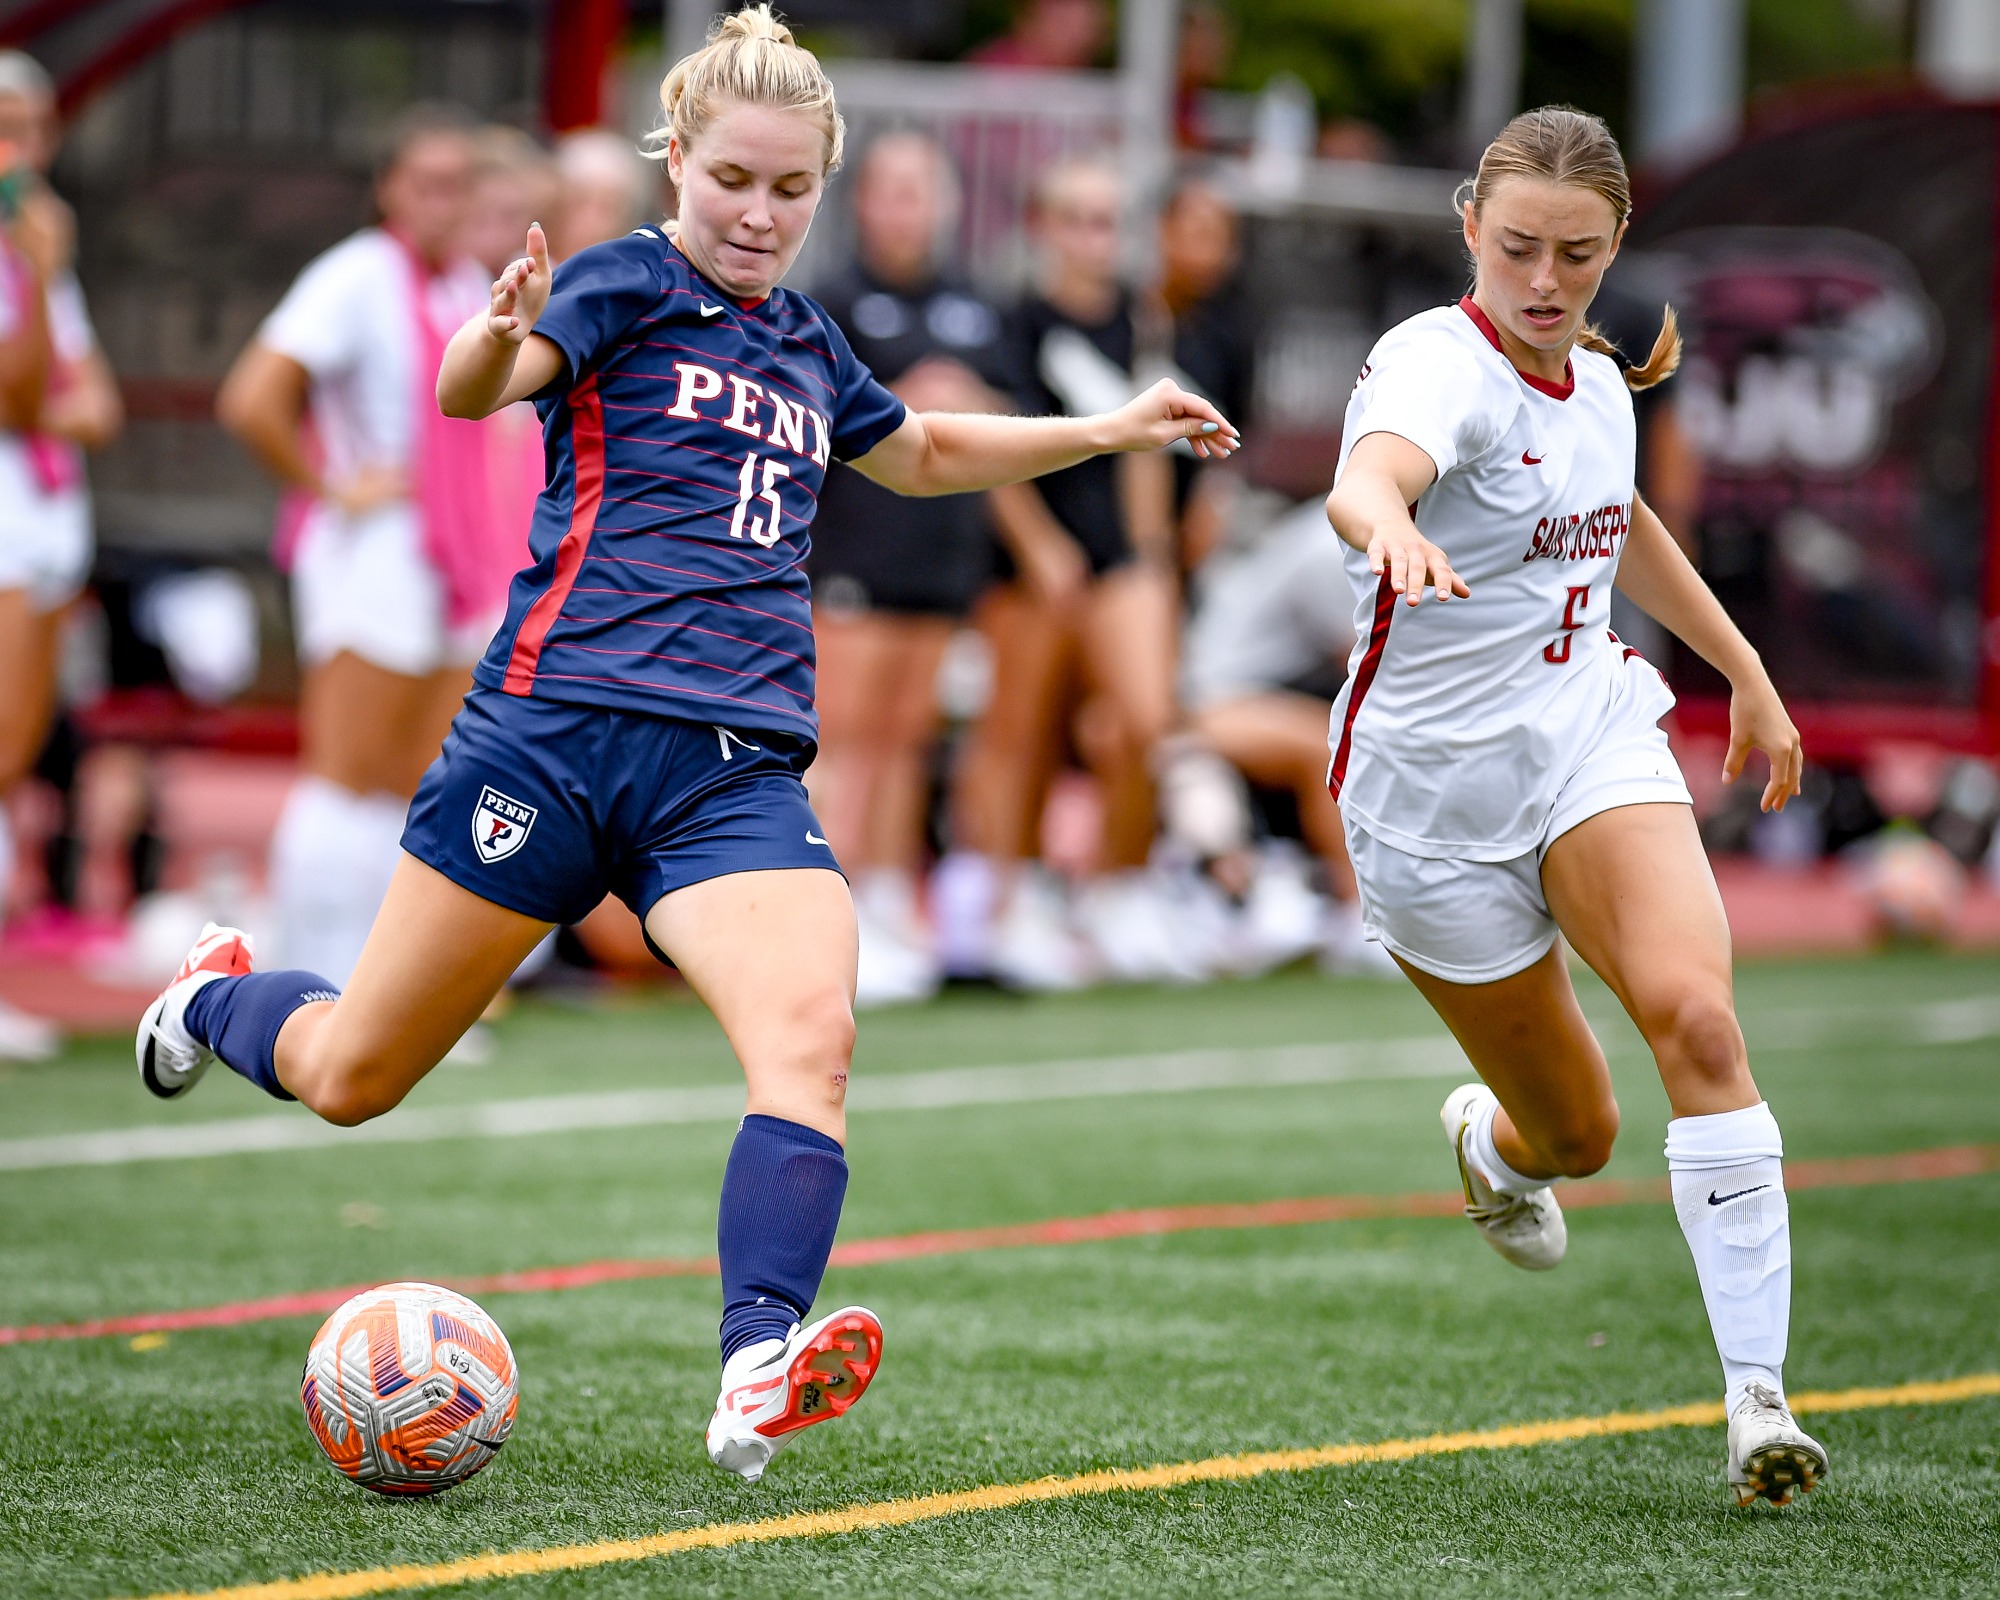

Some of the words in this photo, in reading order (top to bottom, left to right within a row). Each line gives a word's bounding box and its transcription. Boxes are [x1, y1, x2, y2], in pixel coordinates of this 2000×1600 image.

[665, 361, 832, 473] PENN
[729, 451, 790, 549] 15
[1543, 584, 1592, 664] 5
[482, 818, 513, 851] P
[484, 793, 531, 823] PENN
